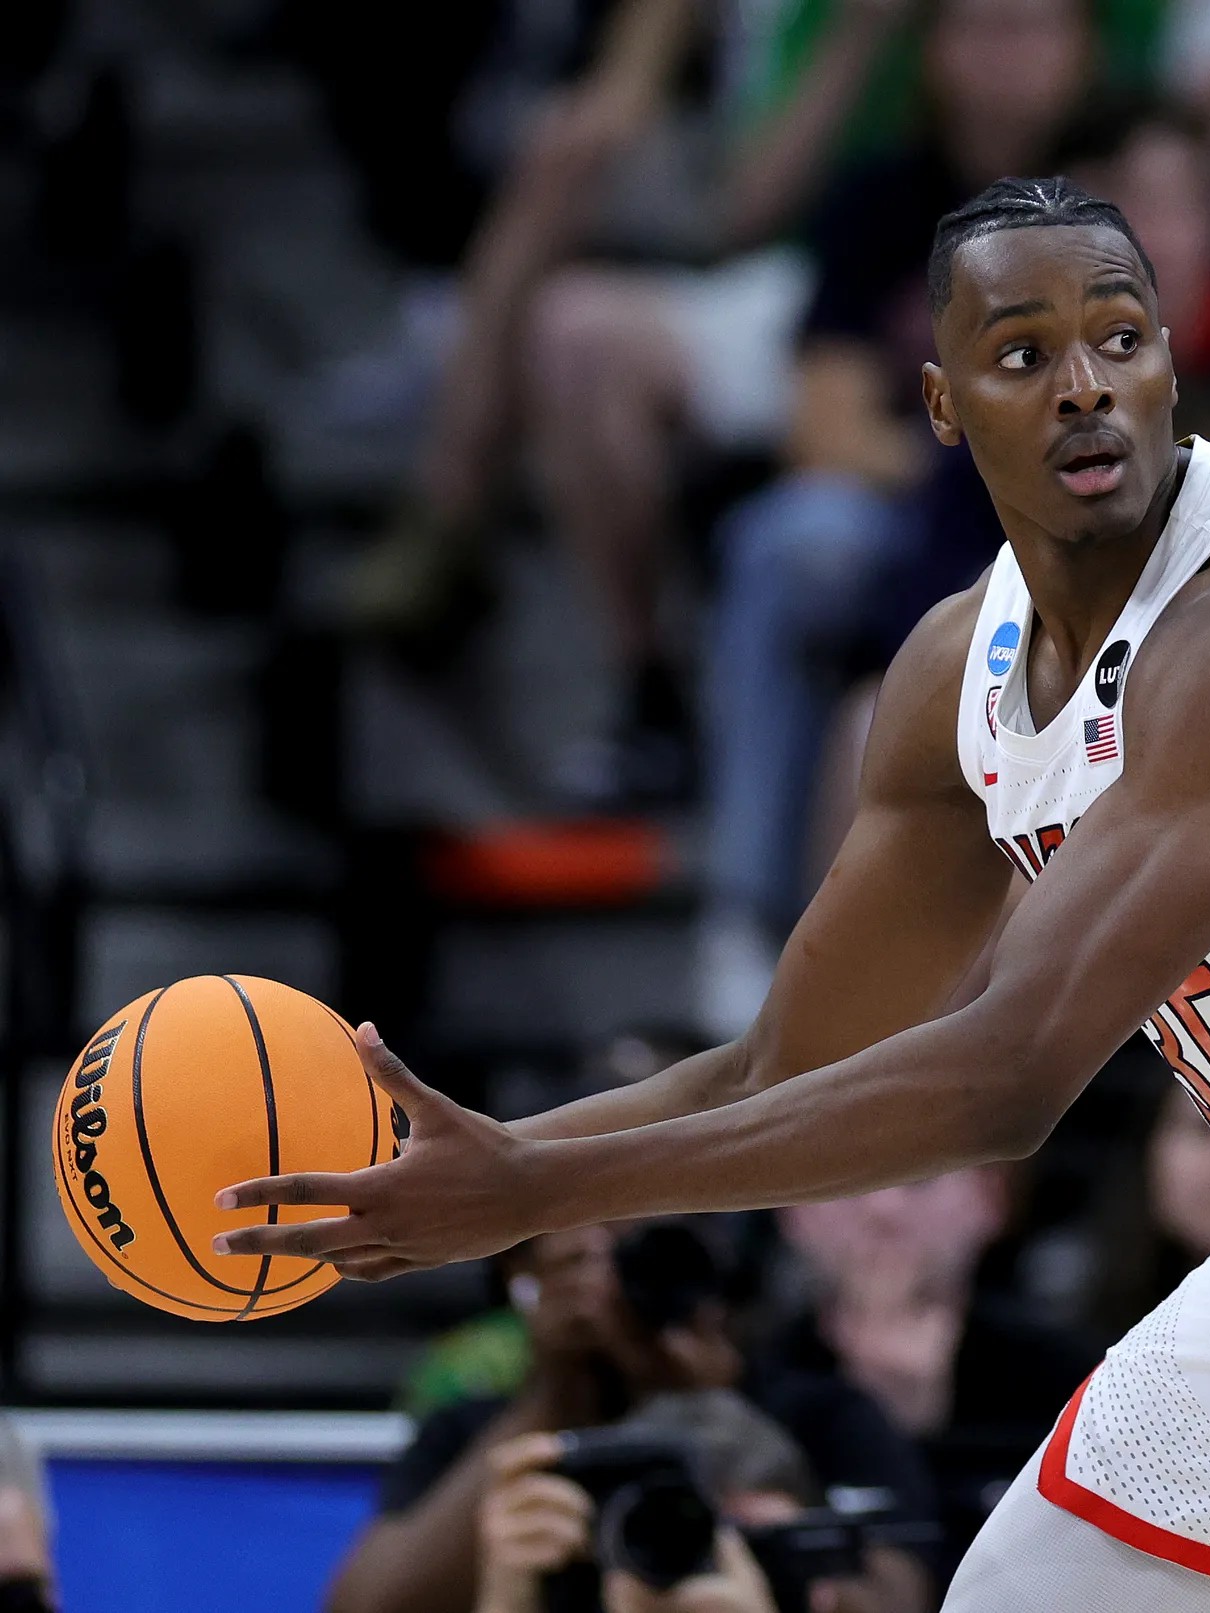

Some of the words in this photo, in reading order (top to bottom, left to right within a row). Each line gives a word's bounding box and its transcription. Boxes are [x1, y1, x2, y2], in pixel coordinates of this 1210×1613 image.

[989, 645, 1016, 662] NCAA
[70, 1018, 136, 1253] Wilson
[66, 1149, 79, 1182] NXT
